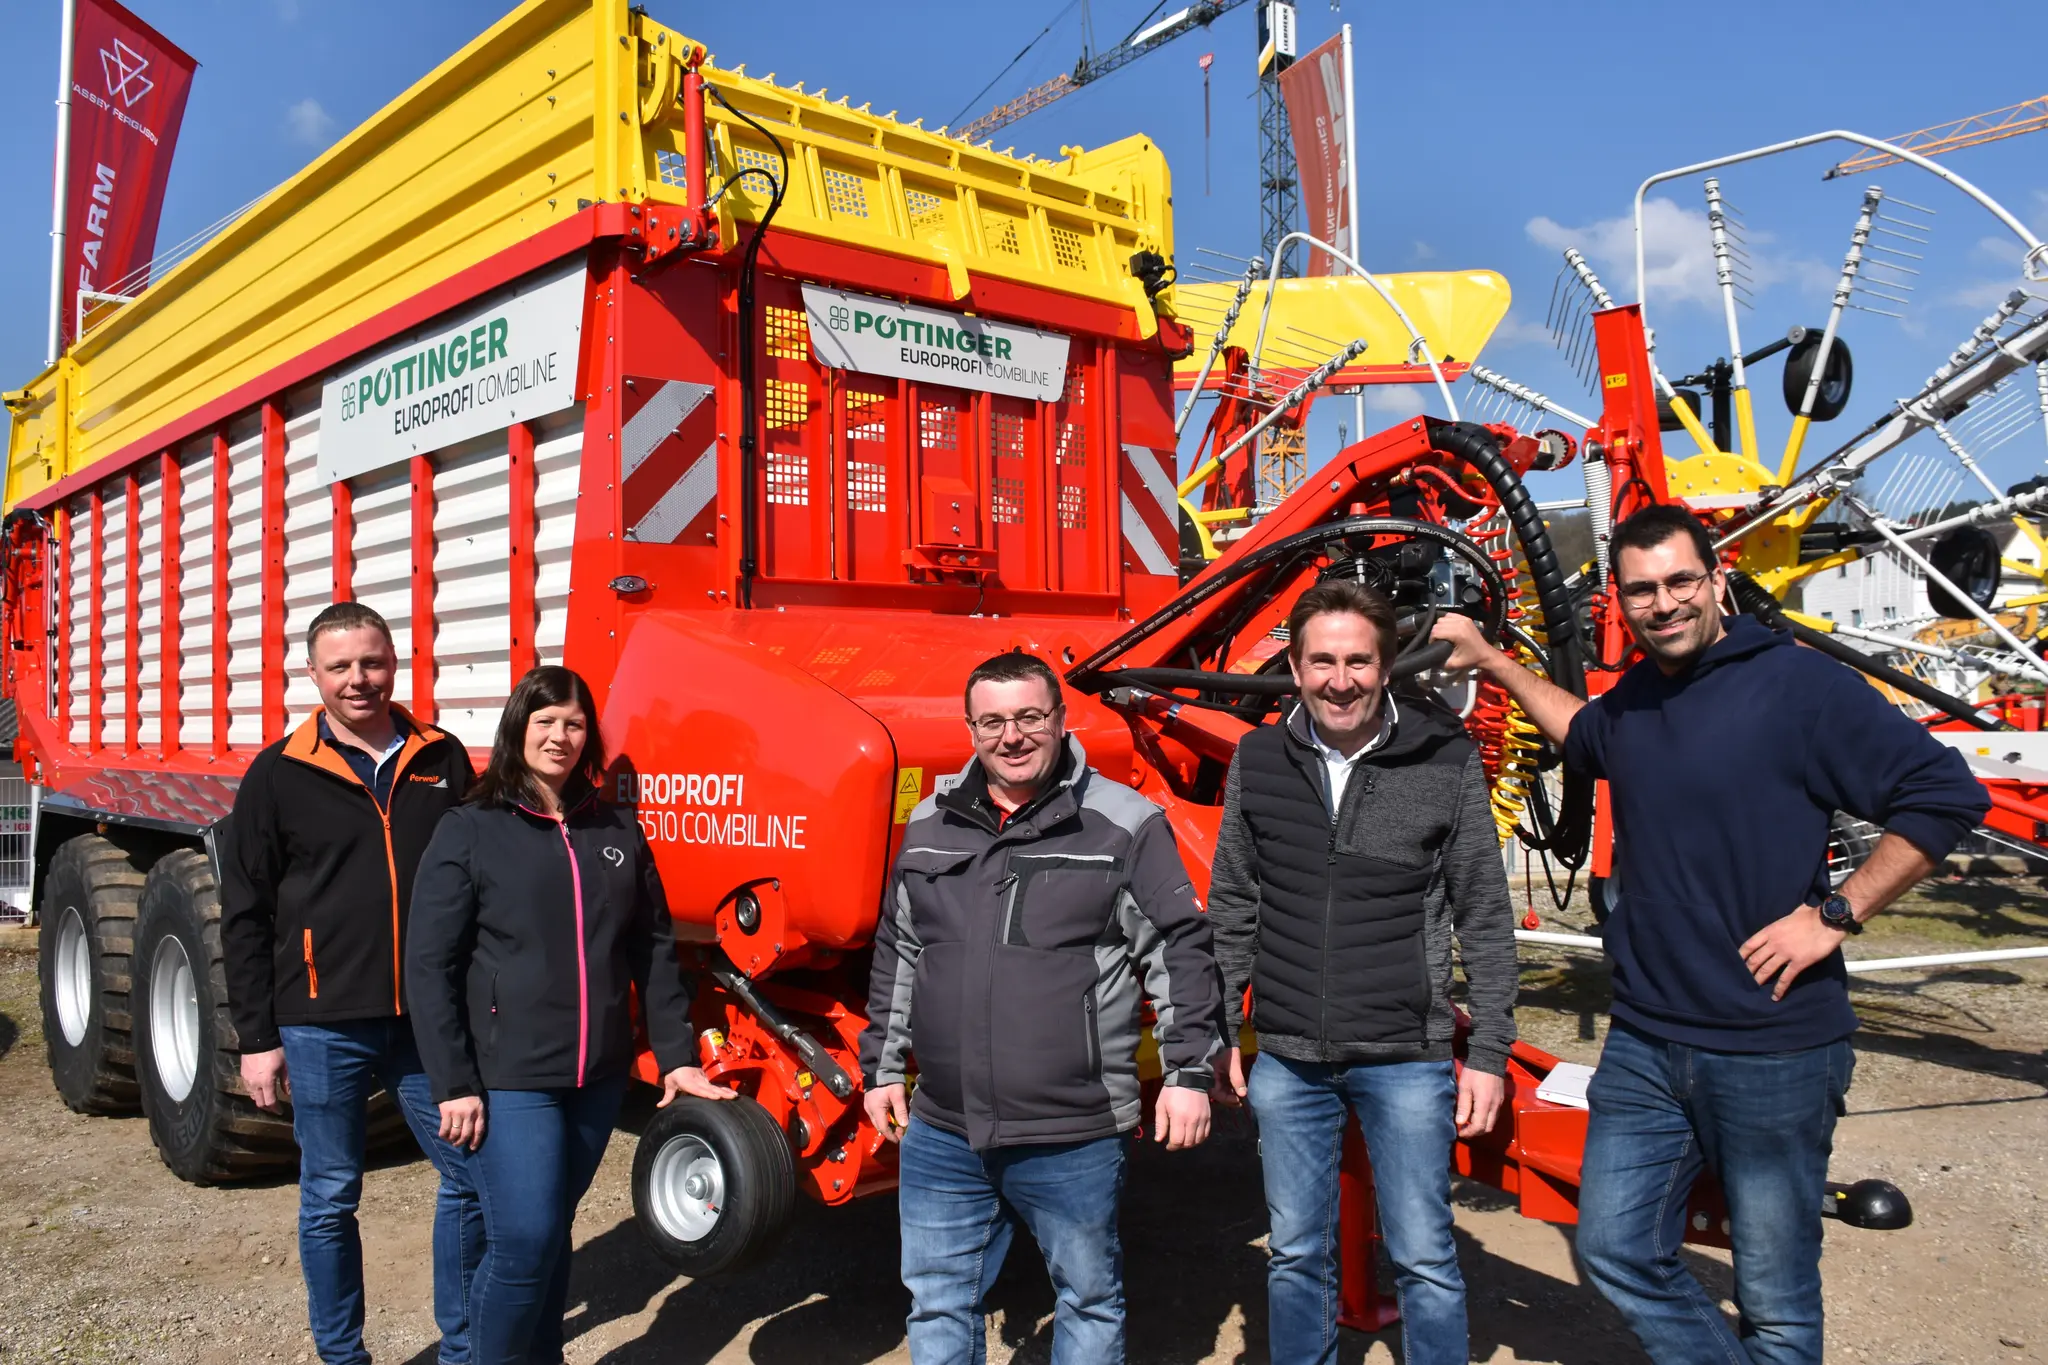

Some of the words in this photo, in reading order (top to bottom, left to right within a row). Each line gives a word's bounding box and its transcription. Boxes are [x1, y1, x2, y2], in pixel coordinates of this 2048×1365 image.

[72, 81, 110, 111] ASSEY
[79, 162, 116, 293] FARM
[855, 310, 1012, 361] PÖTTINGER
[359, 317, 508, 414] PÖTTINGER
[900, 348, 982, 375] EUROPROFI
[986, 362, 1049, 387] COMBILINE
[395, 383, 473, 435] EUROPROFI
[478, 352, 557, 405] COMBILINE
[1416, 526, 1456, 544] EVOLUTION
[410, 773, 439, 783] Perwolf
[617, 773, 744, 806] EUROPROFI
[682, 811, 807, 849] COMBILINE
